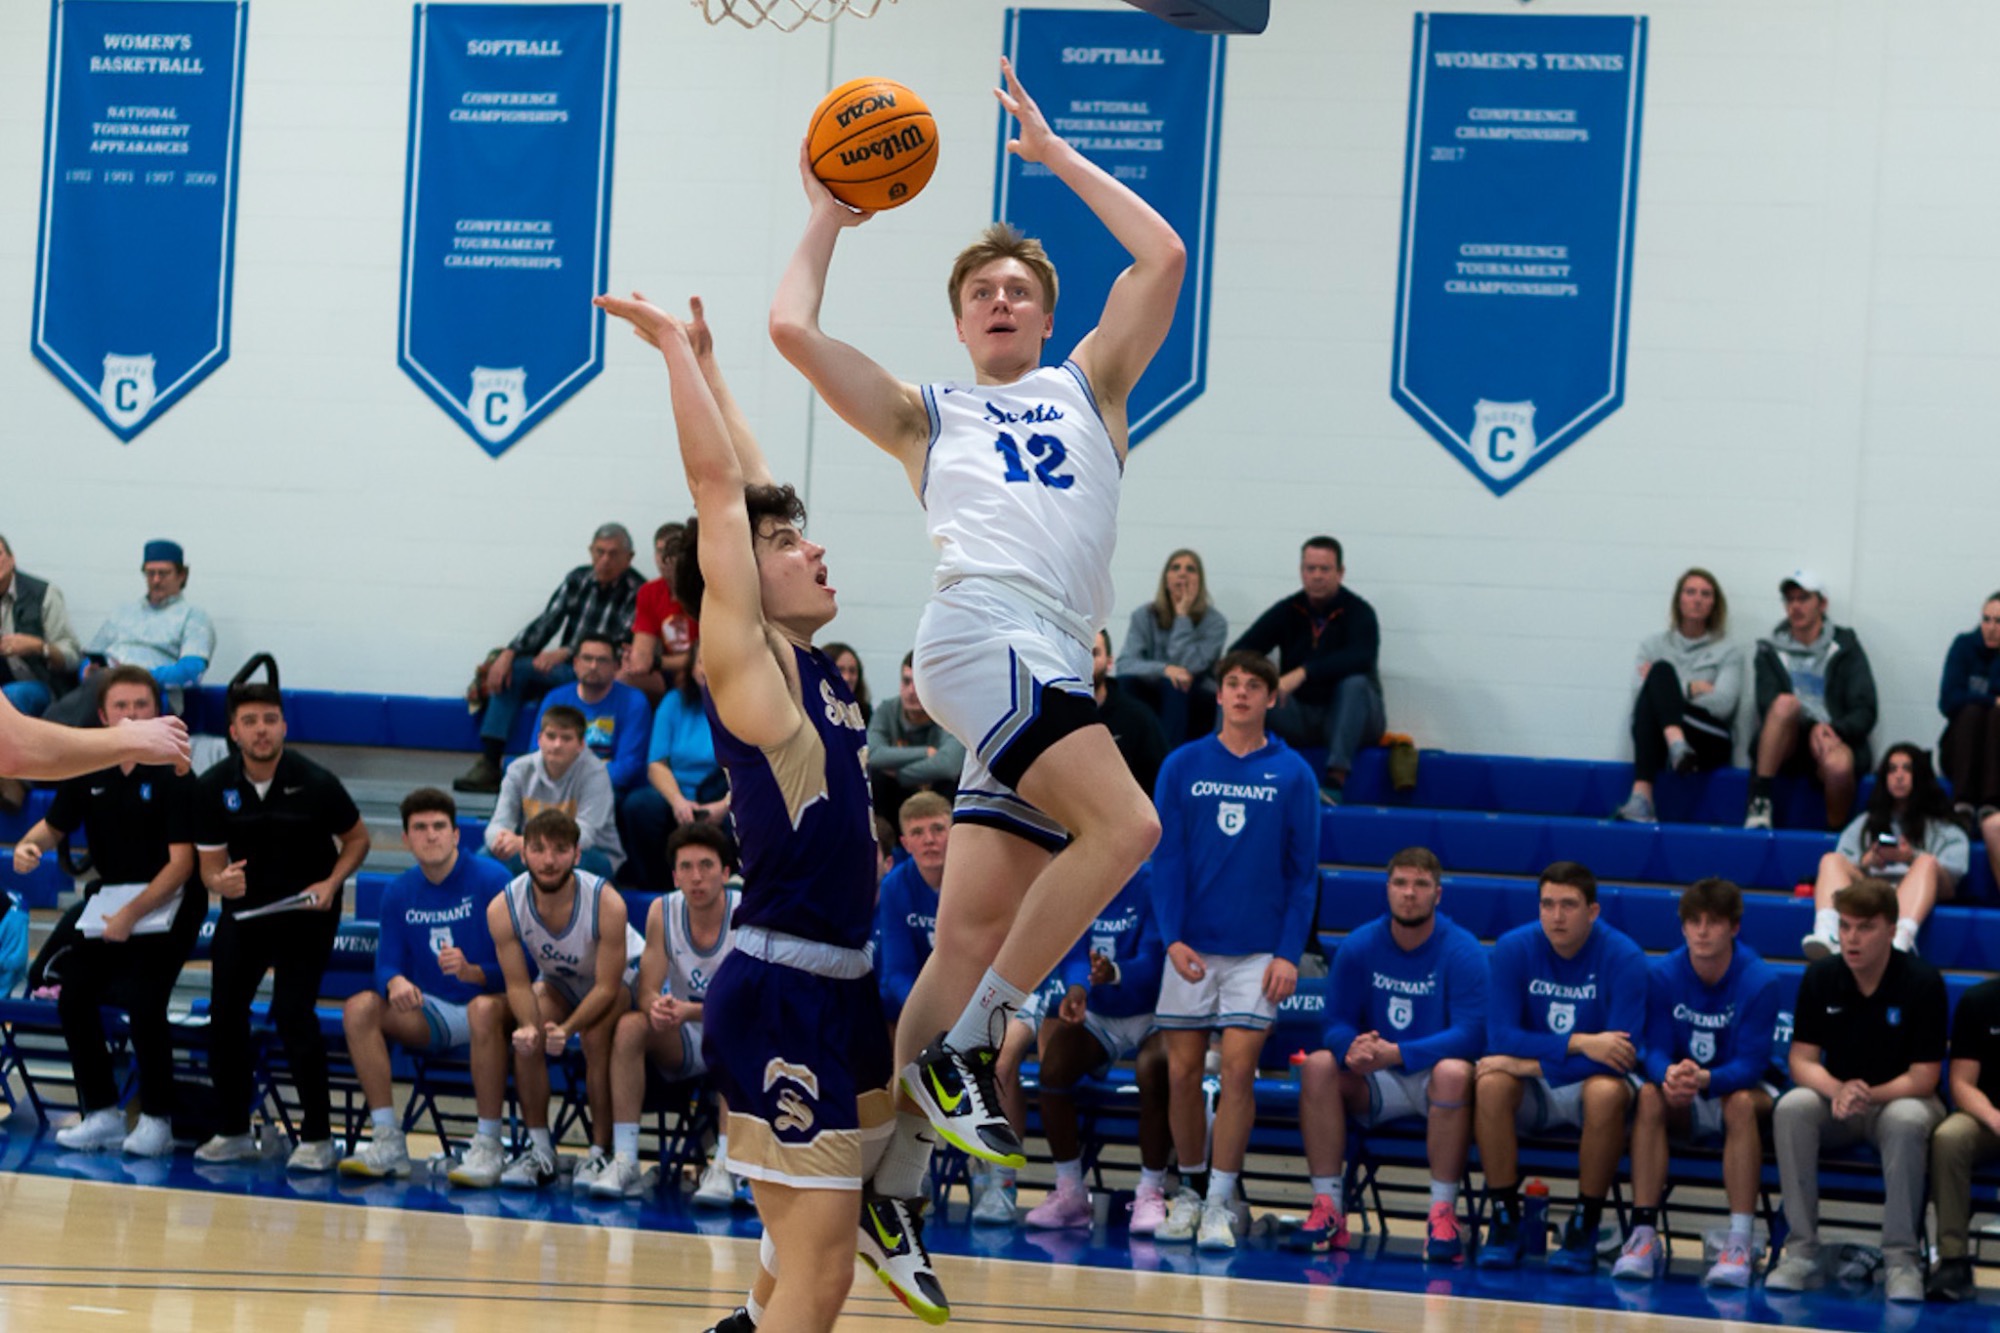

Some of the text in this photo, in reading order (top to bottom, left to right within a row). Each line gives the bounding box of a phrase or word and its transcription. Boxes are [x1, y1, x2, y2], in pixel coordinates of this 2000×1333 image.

[103, 34, 192, 50] WOMEN'S
[467, 40, 563, 56] SOFTBALL
[1061, 47, 1165, 65] SOFTBALL
[1434, 52, 1625, 71] WOMEN'S TENNIS
[90, 56, 203, 74] BASKETBALL
[461, 92, 558, 105] CONFERENCE
[1070, 100, 1149, 114] NATIONAL
[107, 106, 177, 119] NATIONAL
[449, 109, 569, 123] CHAMPIONSHIPS
[836, 92, 896, 128] NCAA
[1467, 107, 1578, 123] CONFERENCE
[93, 122, 190, 137] TOURNAMENT
[1054, 118, 1165, 133] TOURNAMENT
[1454, 126, 1590, 143] CHAMPIONSHIPS
[90, 140, 189, 154] APPEARANCES
[838, 124, 926, 167] Wilson
[1063, 136, 1164, 152] PPEARANCES
[455, 219, 552, 233] CONFERENCE
[453, 236, 556, 251] TOURNAMENT
[1459, 244, 1569, 259] CONFERENCE
[444, 254, 563, 269] CHAMPIONSHIPS
[1456, 261, 1571, 278] TOURNAMENT
[1444, 280, 1579, 297] CHAMPIONSHIPS
[115, 379, 137, 412] C
[485, 391, 509, 426] C
[1488, 426, 1516, 463] C
[994, 430, 1076, 490] 12
[1190, 780, 1279, 802] COVENANT
[1224, 812, 1238, 829] C
[405, 902, 473, 925] COVENANT
[1554, 1012, 1567, 1030] C
